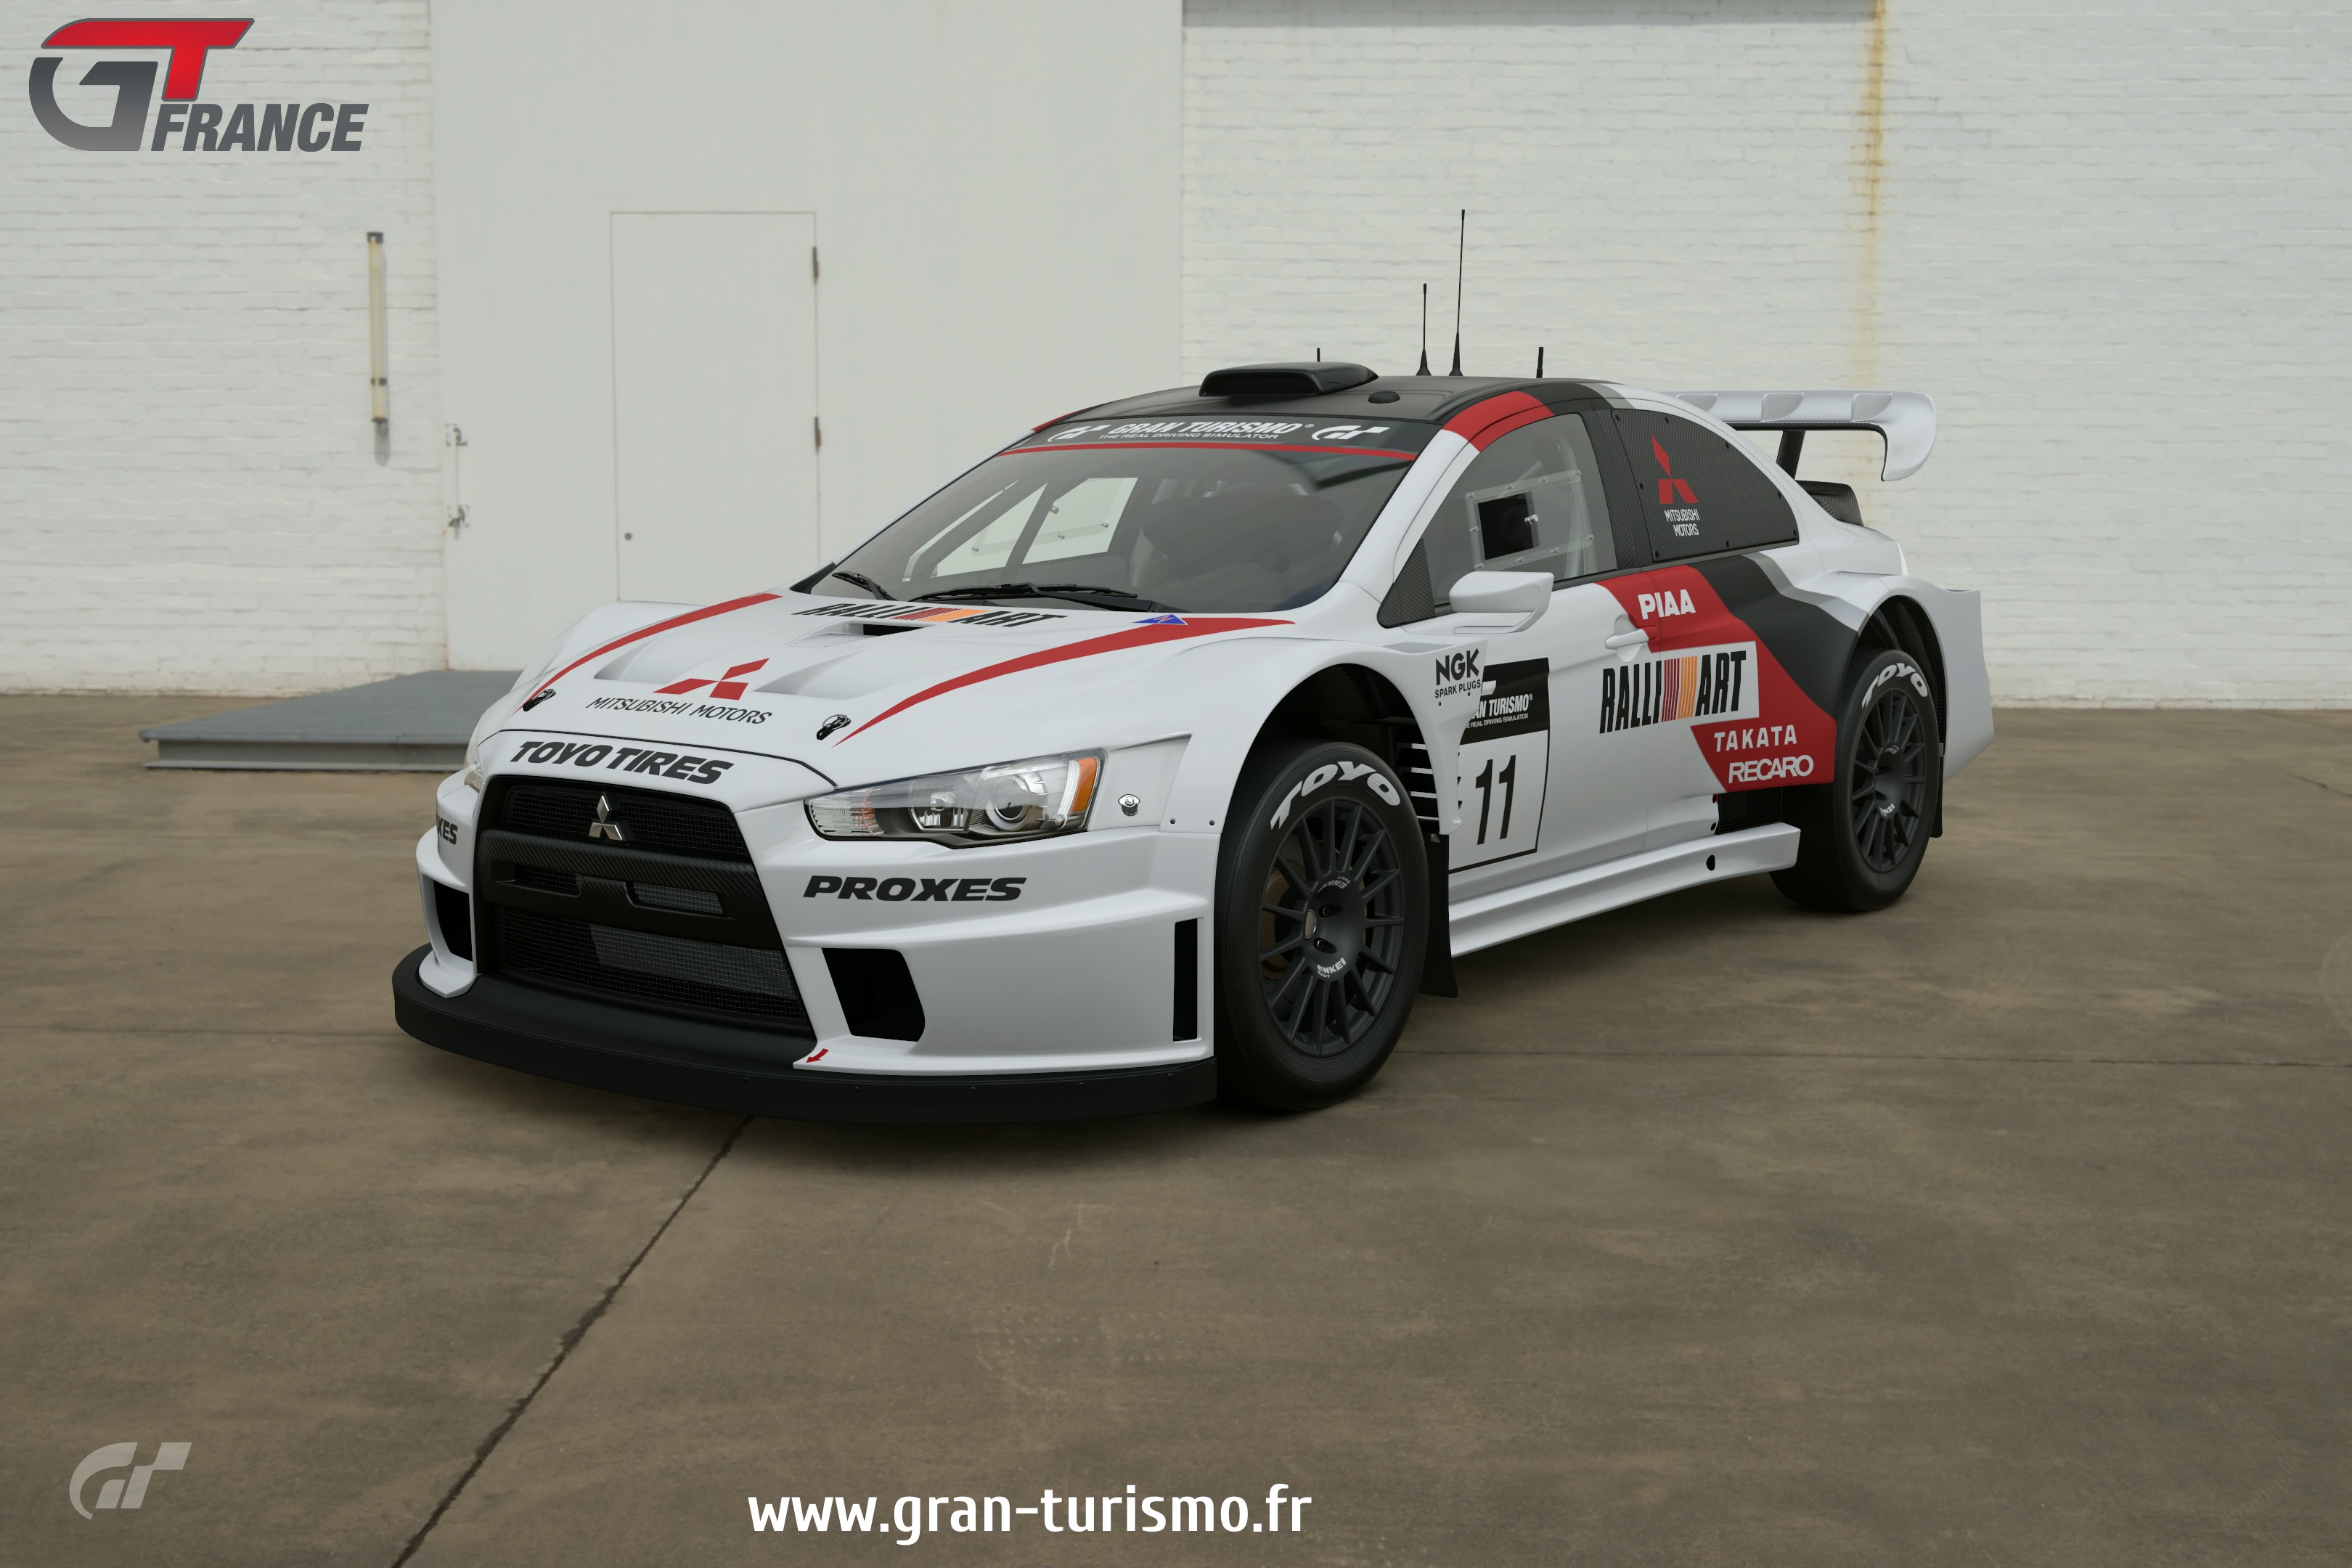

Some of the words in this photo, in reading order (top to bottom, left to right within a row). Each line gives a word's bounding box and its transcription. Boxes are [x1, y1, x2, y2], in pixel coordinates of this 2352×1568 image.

[1108, 422, 1185, 434] GRAN
[1665, 508, 1700, 523] MITSUBISHI
[1673, 523, 1699, 537] MOTORS
[1638, 589, 1696, 620] PIAA
[1435, 648, 1479, 686] NGK
[1434, 685, 1458, 698] SPARK
[1458, 679, 1482, 693] PLUGS
[1861, 662, 1928, 709] TOYO
[586, 697, 693, 714] MITSUBISHI
[689, 704, 772, 724] MOTORS
[1471, 701, 1487, 720] AN
[1471, 719, 1484, 729] REAL
[1483, 716, 1503, 727] DRIVING
[1503, 712, 1529, 723] SIMULATOR
[1714, 724, 1797, 753] TAKATA
[510, 741, 614, 767] TOYO
[606, 747, 735, 785] TIRES
[1728, 755, 1814, 784] RECARO
[1270, 761, 1400, 830] TOYO
[1475, 754, 1516, 846] 11
[437, 814, 458, 845] XES
[803, 875, 1027, 902] PROXES
[1317, 957, 1347, 974] ENKEI
